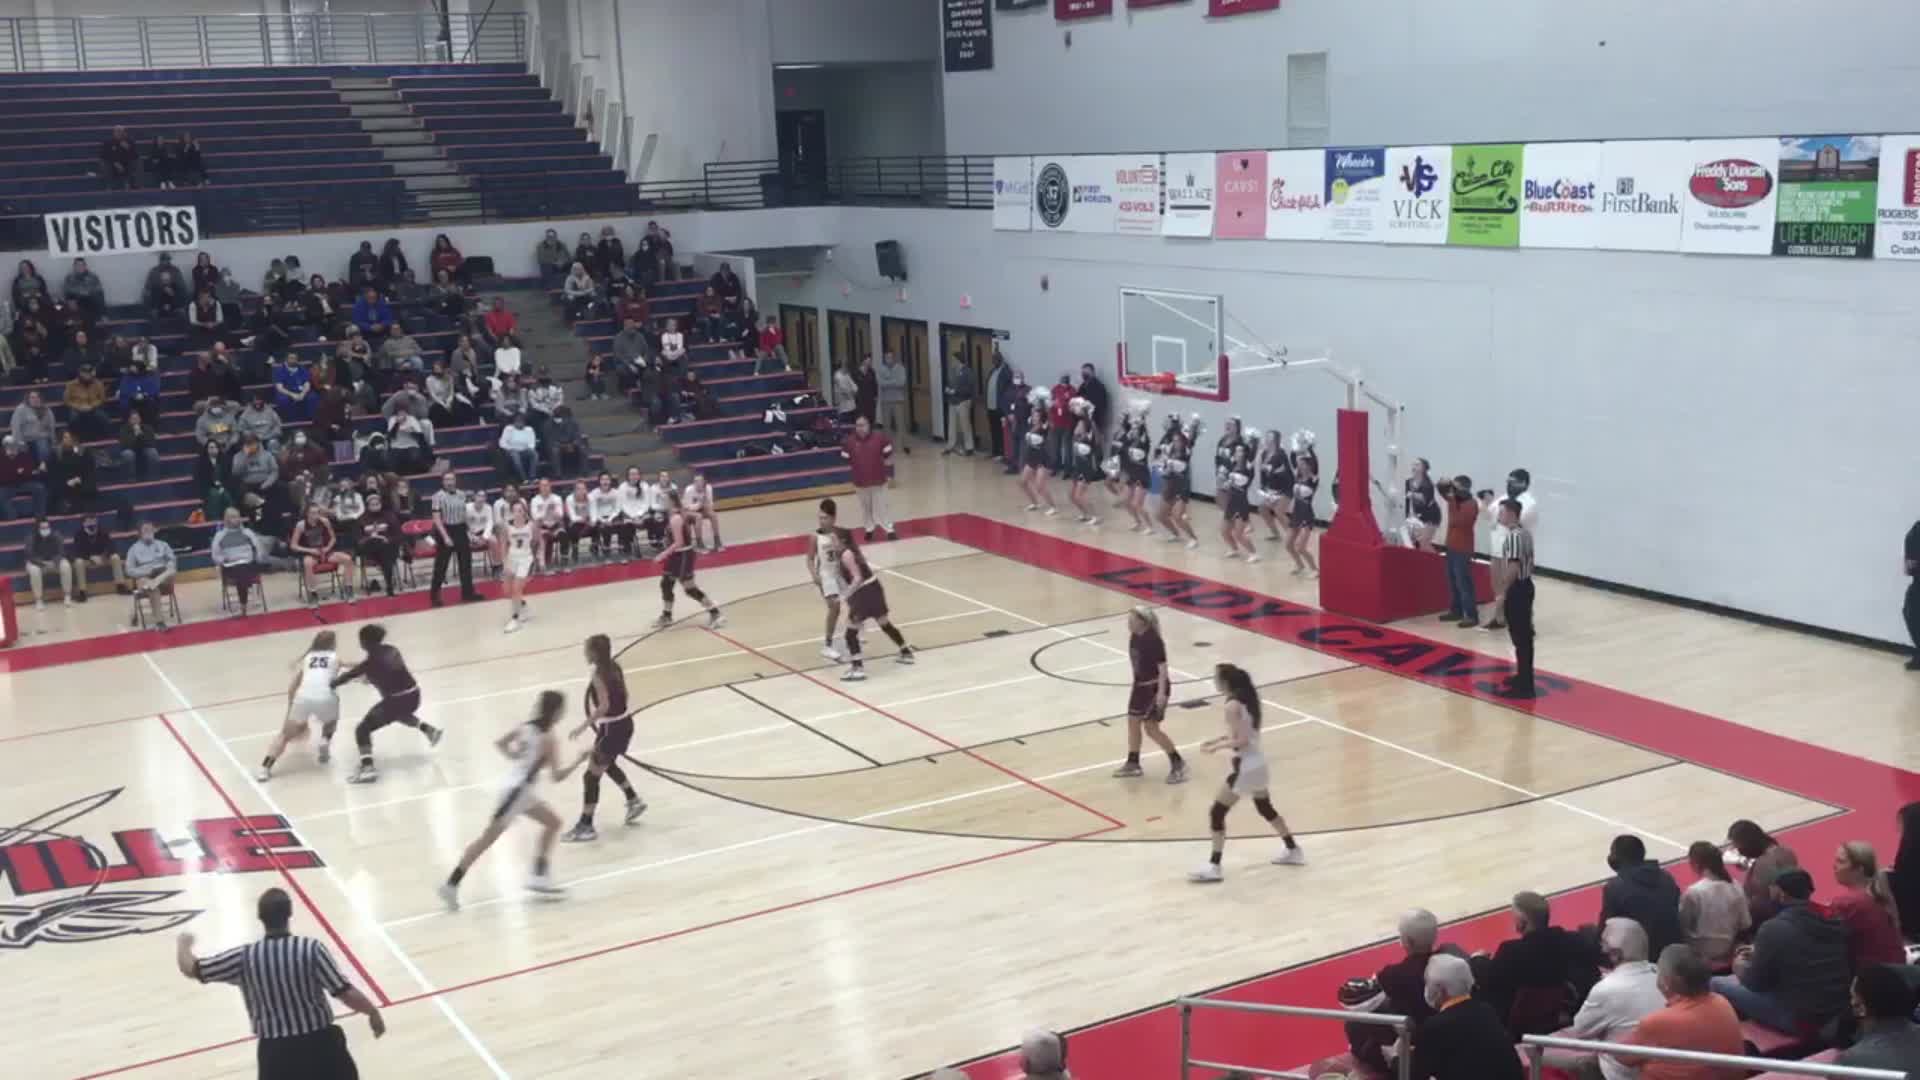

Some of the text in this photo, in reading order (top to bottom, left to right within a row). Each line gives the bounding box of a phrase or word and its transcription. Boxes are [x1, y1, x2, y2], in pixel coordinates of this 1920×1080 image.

[1393, 199, 1442, 219] VICK
[1602, 192, 1679, 213] FirstBank
[51, 210, 194, 252] VISITORS
[1781, 224, 1807, 243] LIFE
[1811, 224, 1867, 245] CHURCH
[1093, 566, 1312, 621] LADY
[309, 656, 329, 669] 25
